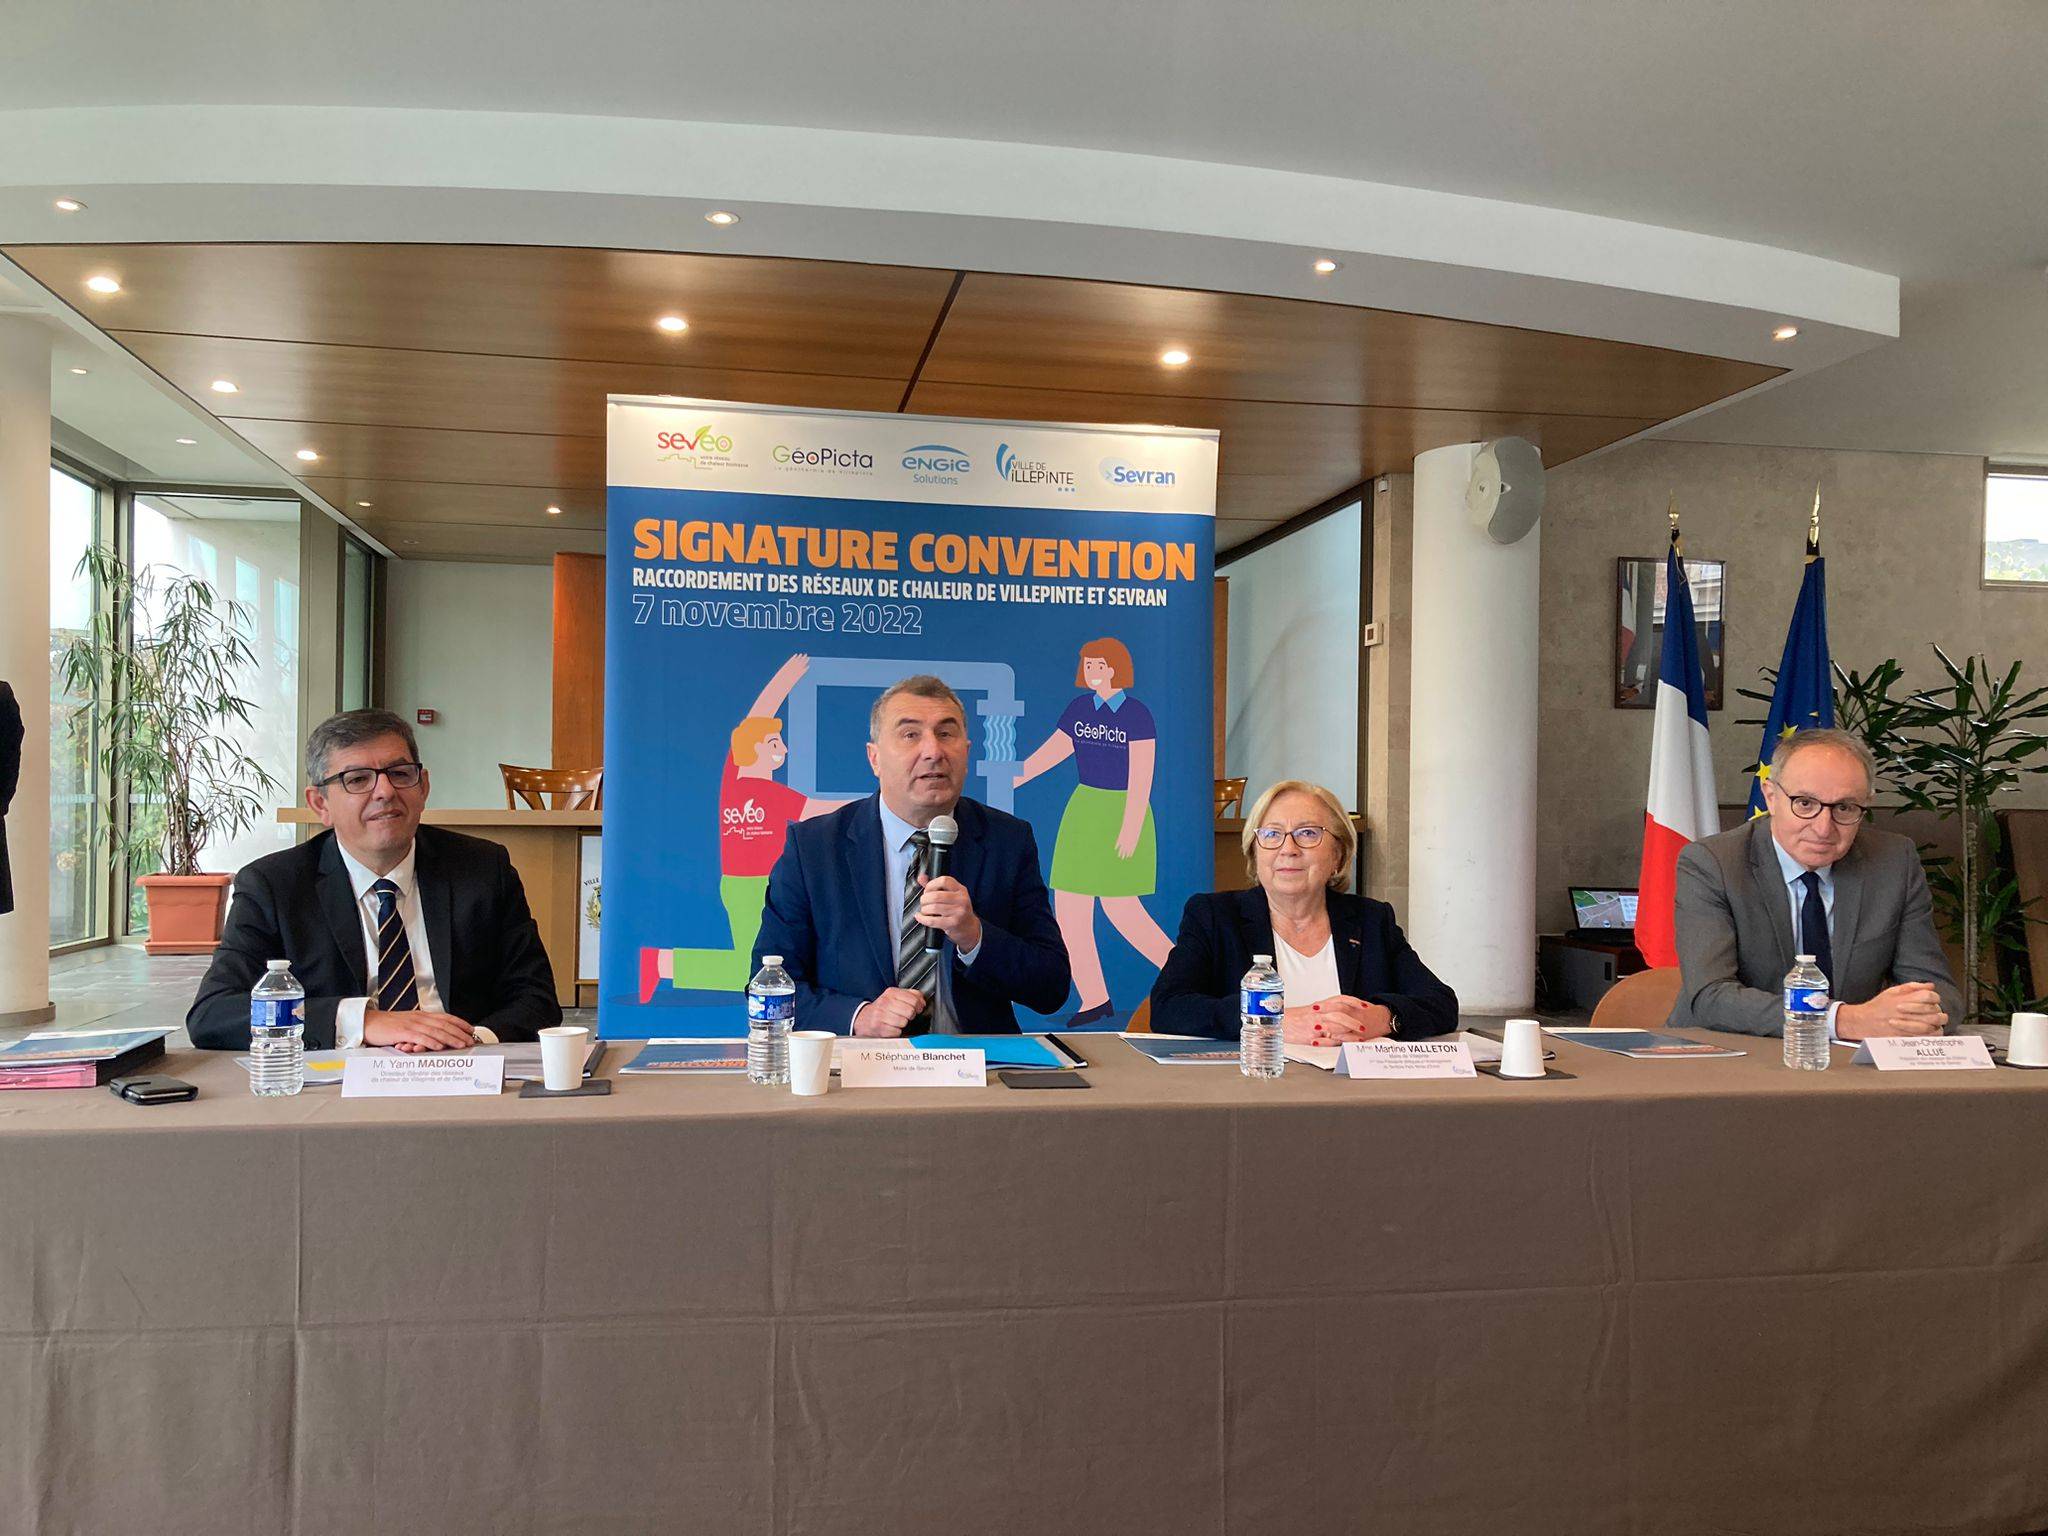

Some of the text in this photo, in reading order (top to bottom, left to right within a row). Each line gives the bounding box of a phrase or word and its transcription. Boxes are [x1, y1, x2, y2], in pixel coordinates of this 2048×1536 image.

[773, 445, 873, 469] GéoPicta
[1036, 462, 1046, 471] DE
[913, 474, 958, 485] Solutions
[1114, 466, 1175, 484] Sevran
[633, 518, 1195, 581] SIGNATURE CONVENTION
[633, 567, 1167, 607] RACCORDEMENT DES RÉSEAUX DE CHALEUR DE VILLEPINTE ET SEVRAN
[633, 594, 922, 635] 7 novembre 2022
[1074, 721, 1126, 743] GéoPicta
[1375, 1045, 1406, 1053] Martine
[1408, 1045, 1458, 1053] VALLETON
[1901, 1038, 1965, 1048] Jean-Christophe
[373, 1059, 473, 1069] M. Yann MADIGOU
[875, 1052, 920, 1063] Stéphane
[922, 1052, 966, 1061] Blanchet
